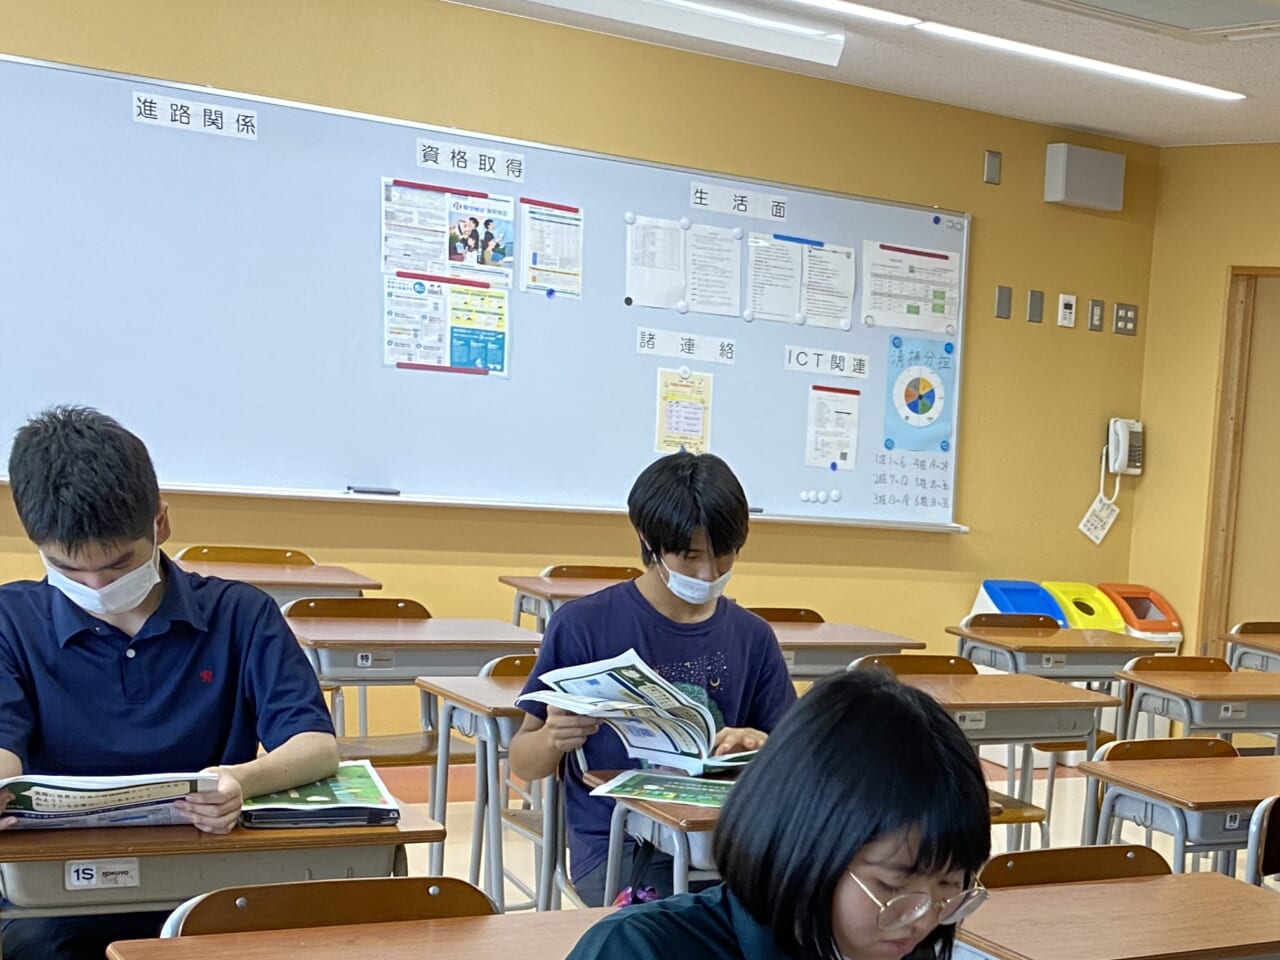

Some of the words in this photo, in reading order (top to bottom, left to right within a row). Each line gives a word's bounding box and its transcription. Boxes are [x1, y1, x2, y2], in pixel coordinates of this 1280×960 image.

[136, 98, 256, 134] 進路関係
[421, 144, 523, 178] 資格取得
[693, 188, 786, 218] 生活面
[640, 331, 734, 359] 諸連絡
[786, 351, 866, 375] ICT関連
[74, 868, 94, 881] 1S
